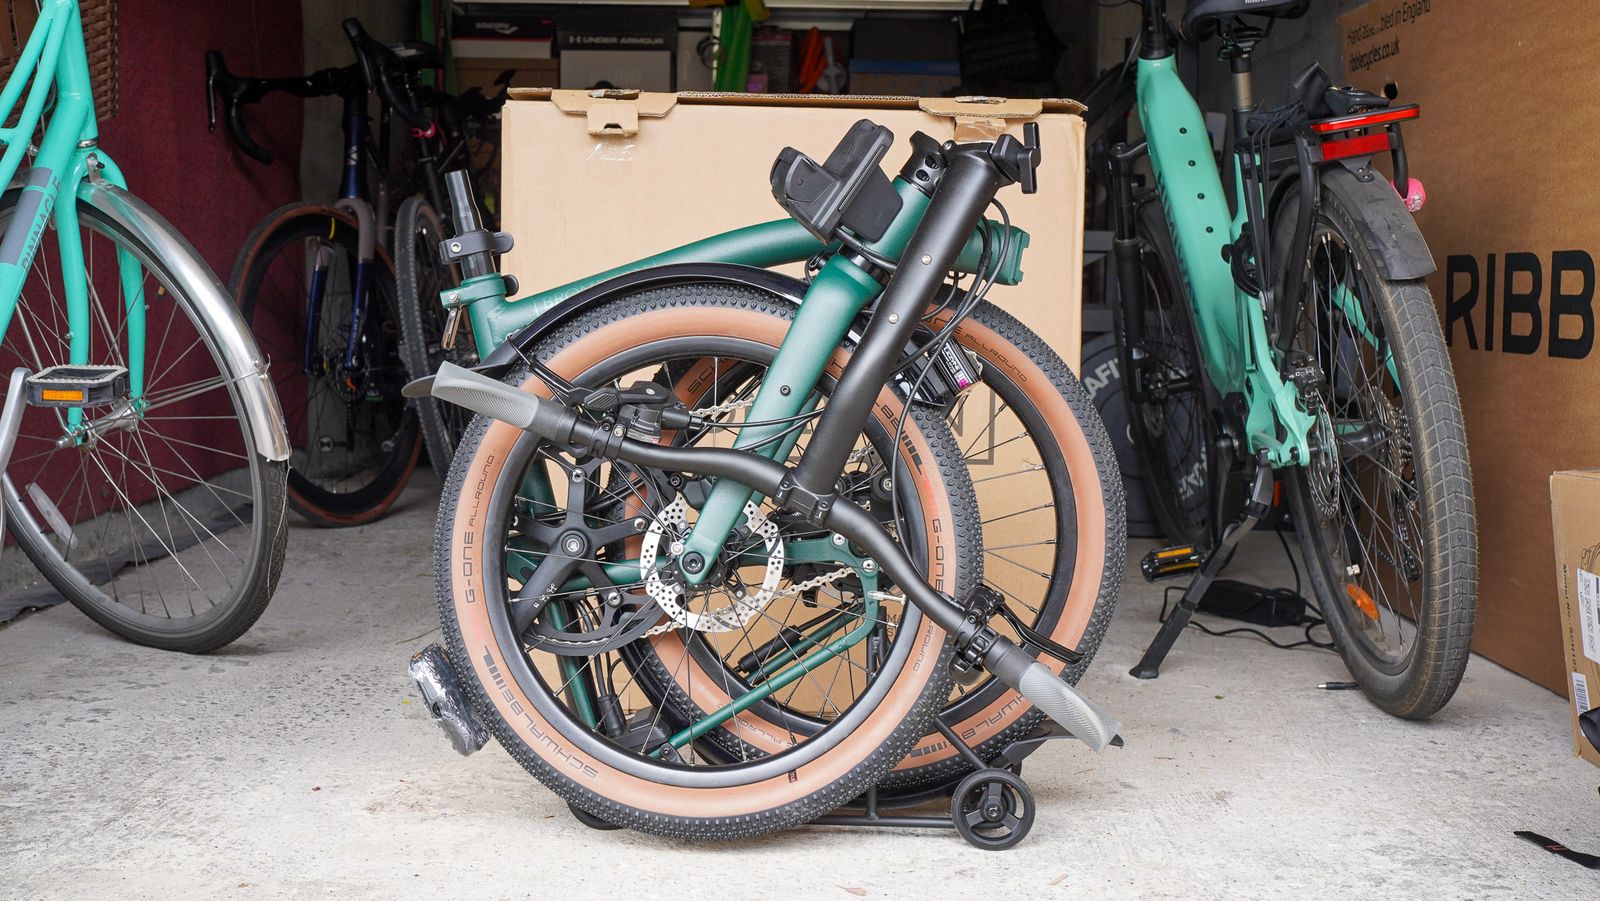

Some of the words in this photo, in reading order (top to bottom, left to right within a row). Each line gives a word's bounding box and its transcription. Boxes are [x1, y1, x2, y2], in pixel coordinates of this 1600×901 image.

[1349, 34, 1400, 72] ribblecycles.co.uk
[1363, 8, 1394, 40] assebled
[1403, 0, 1430, 24] England
[1446, 250, 1596, 360] RIBB
[965, 334, 1028, 383] ALLROUND
[468, 454, 495, 528] ALLROUND
[462, 531, 476, 604] G-ONE
[932, 518, 945, 592] G-ONE
[502, 688, 599, 779] SCHWALBE
